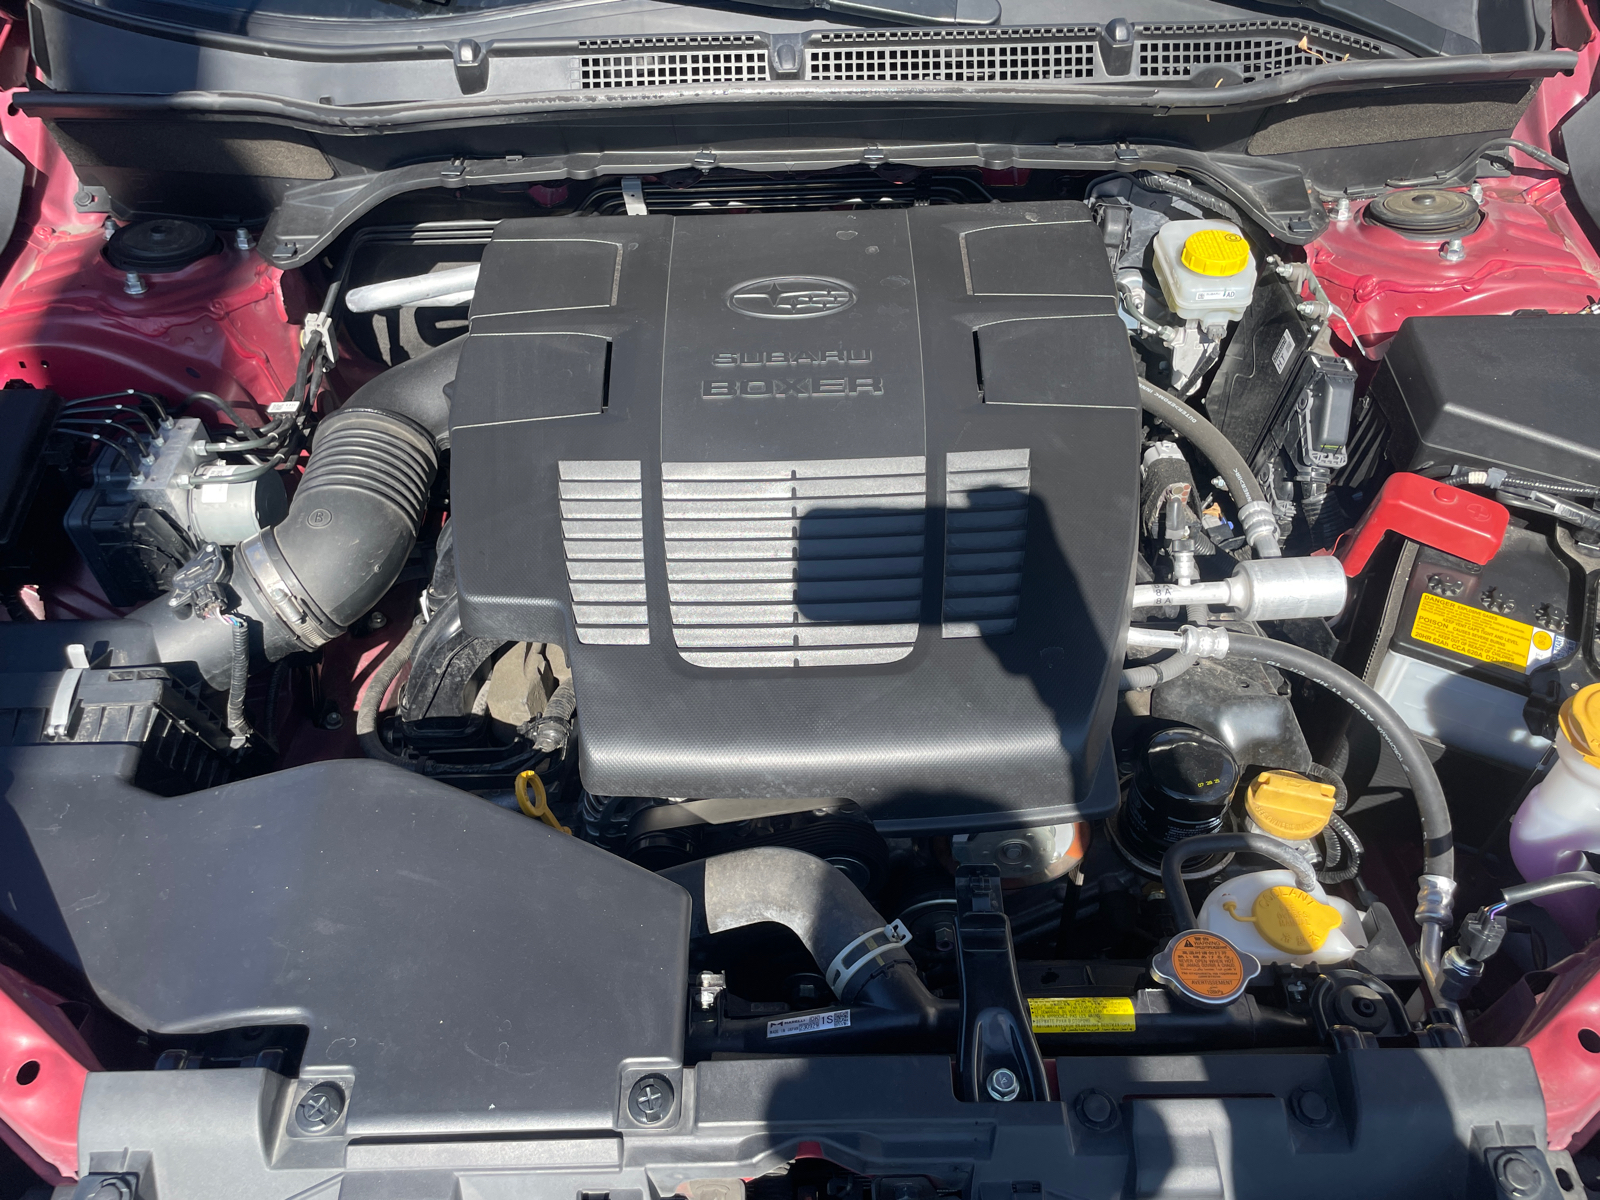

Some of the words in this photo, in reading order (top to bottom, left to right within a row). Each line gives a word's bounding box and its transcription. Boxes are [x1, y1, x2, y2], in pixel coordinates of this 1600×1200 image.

[712, 350, 872, 366] SUBARU
[702, 377, 884, 399] BOXER
[1424, 595, 1456, 608] DANGER
[1457, 606, 1482, 616] EXPLOSIVE
[1482, 613, 1498, 621] GASES
[1418, 616, 1449, 629] POISON
[1452, 627, 1471, 636] CAUSES
[1471, 633, 1489, 641] SEVERE
[1489, 639, 1506, 647] BURNS
[1504, 637, 1519, 645] LEVEL
[1414, 632, 1432, 641] 20HR
[1432, 637, 1449, 647] 62Ah
[1451, 644, 1467, 652] CCA
[1467, 648, 1483, 658] 620A
[1467, 643, 1484, 652] REACH
[1491, 651, 1515, 661] CHILDREN
[1259, 887, 1316, 907] COOLANT
